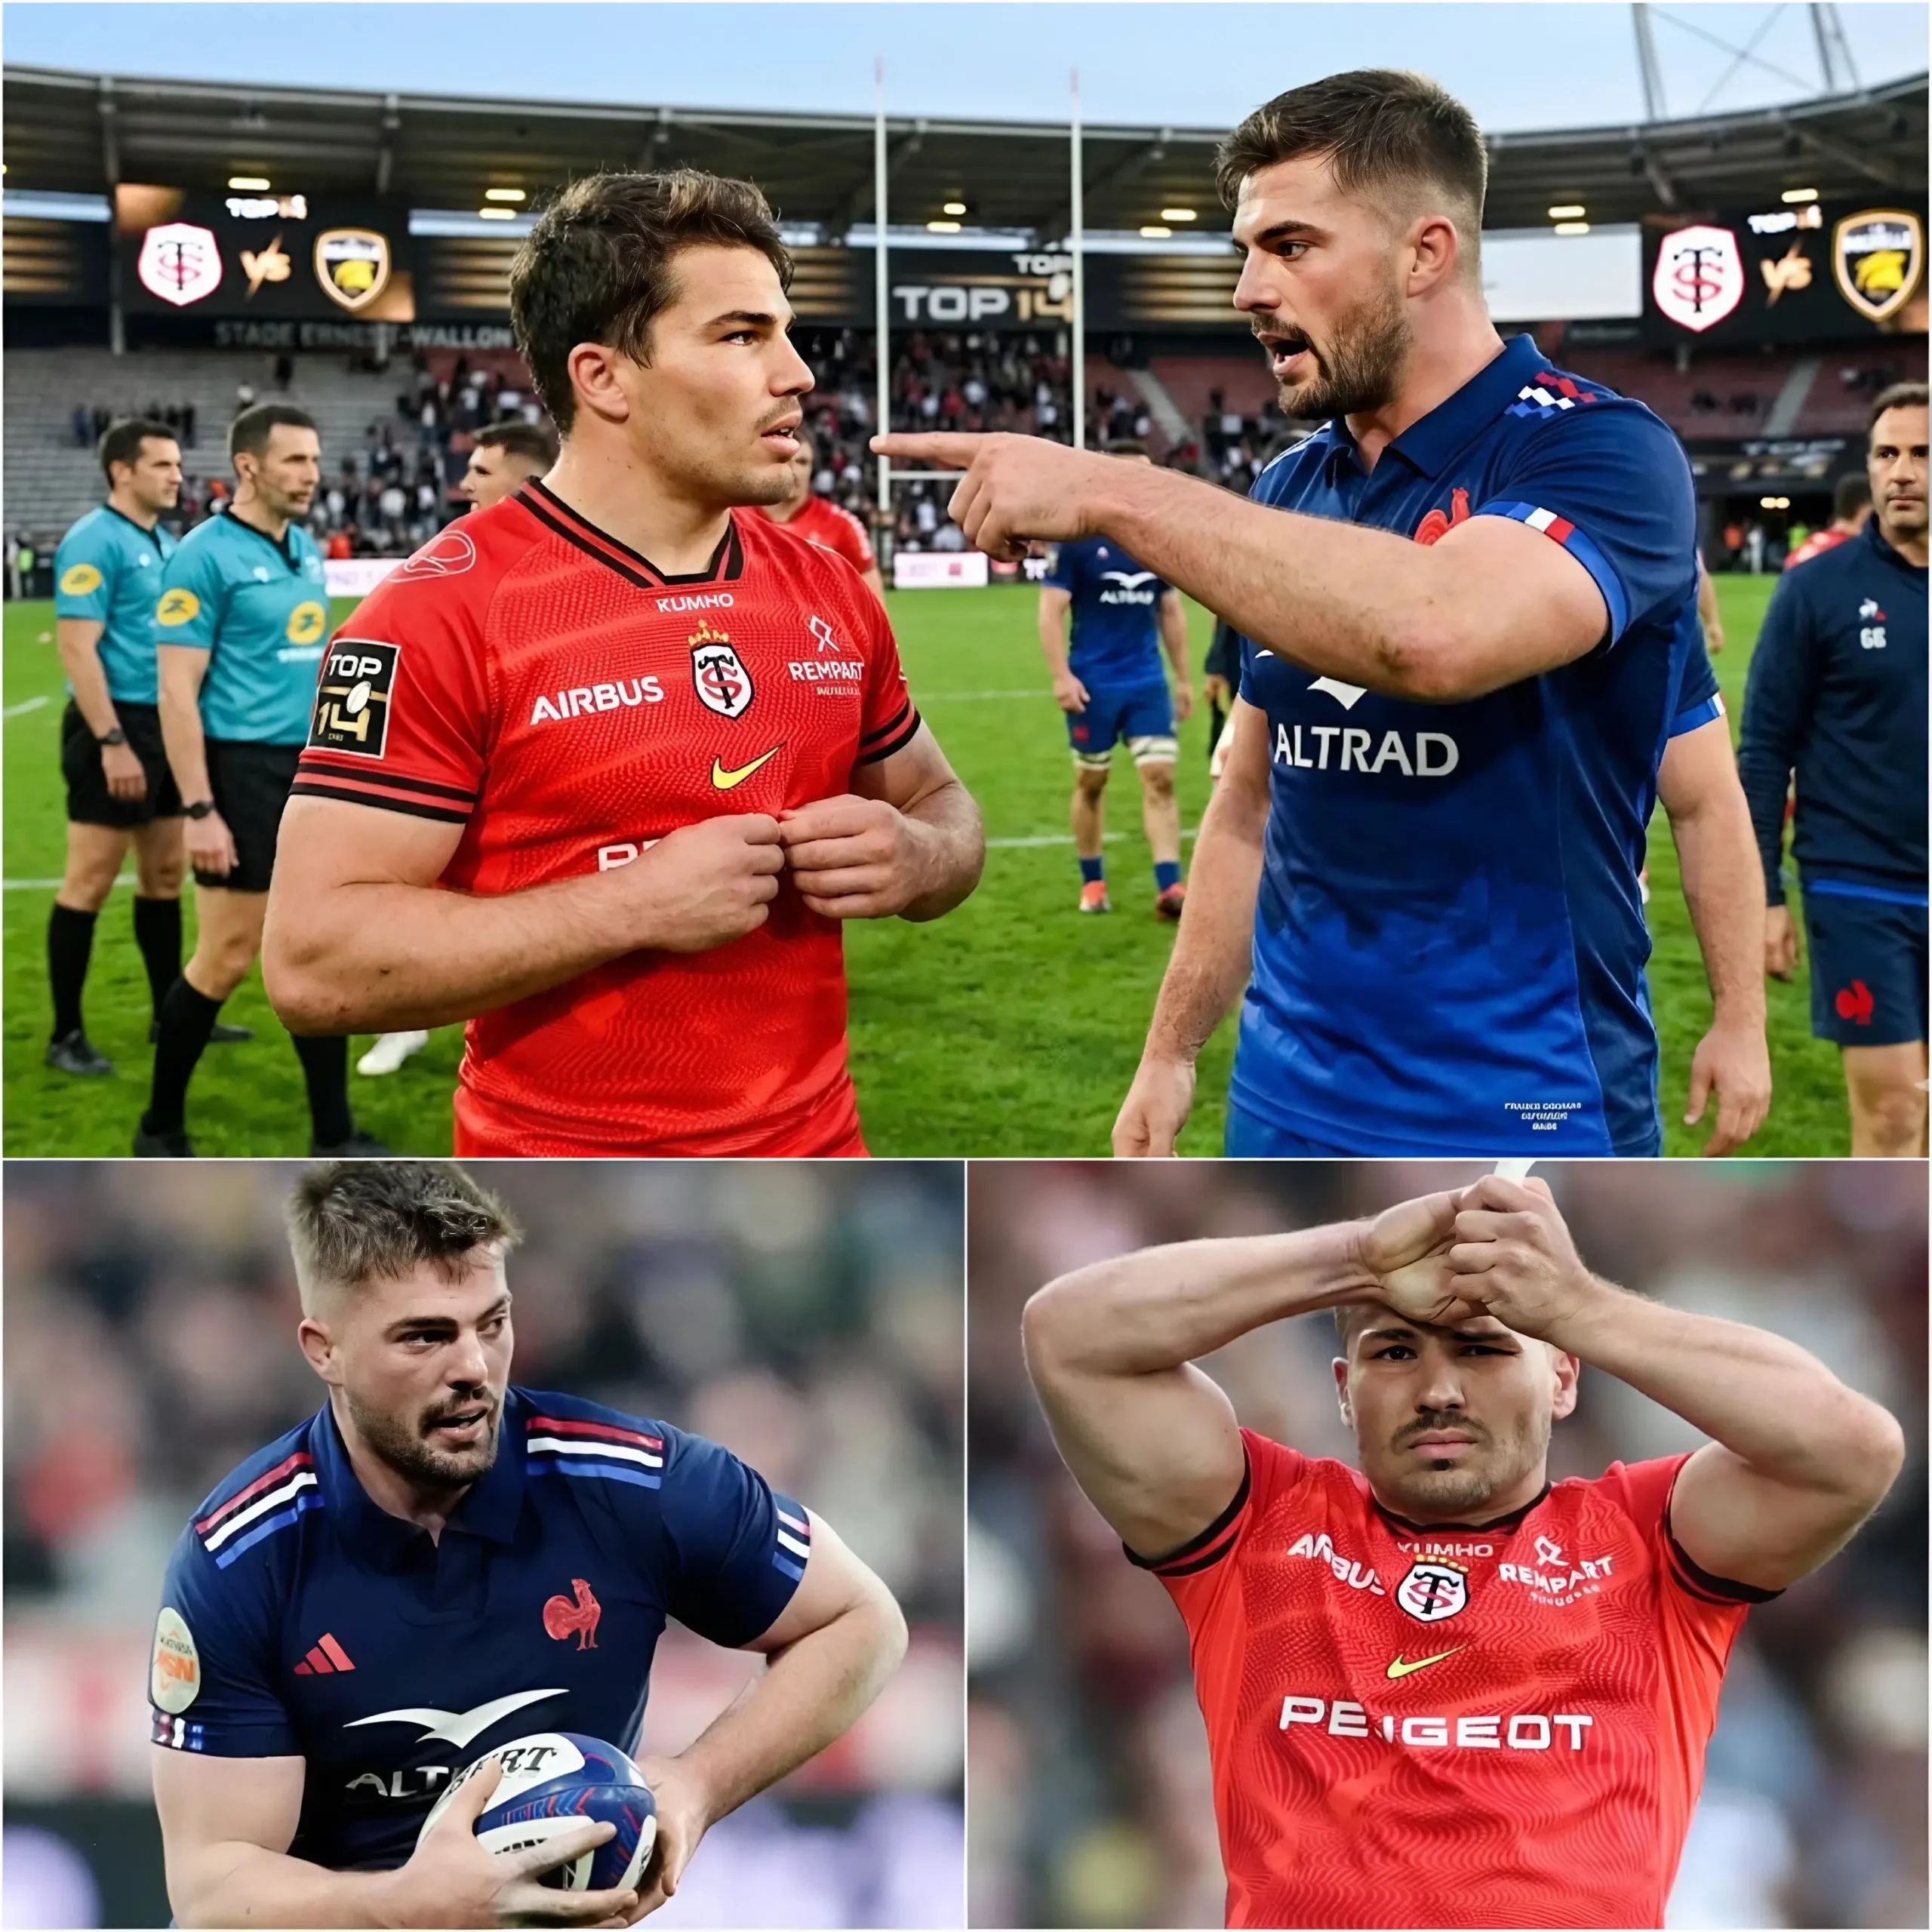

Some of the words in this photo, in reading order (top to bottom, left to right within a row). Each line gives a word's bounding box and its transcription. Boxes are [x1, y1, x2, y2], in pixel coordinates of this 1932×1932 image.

[892, 285, 1010, 321] TOP
[214, 321, 295, 345] STADE
[655, 592, 735, 613] KUMHO
[329, 654, 383, 678] TOP
[530, 675, 664, 725] AIRBUS
[318, 701, 371, 742] 14
[1273, 723, 1460, 777] ALTRAD
[598, 838, 661, 872] P
